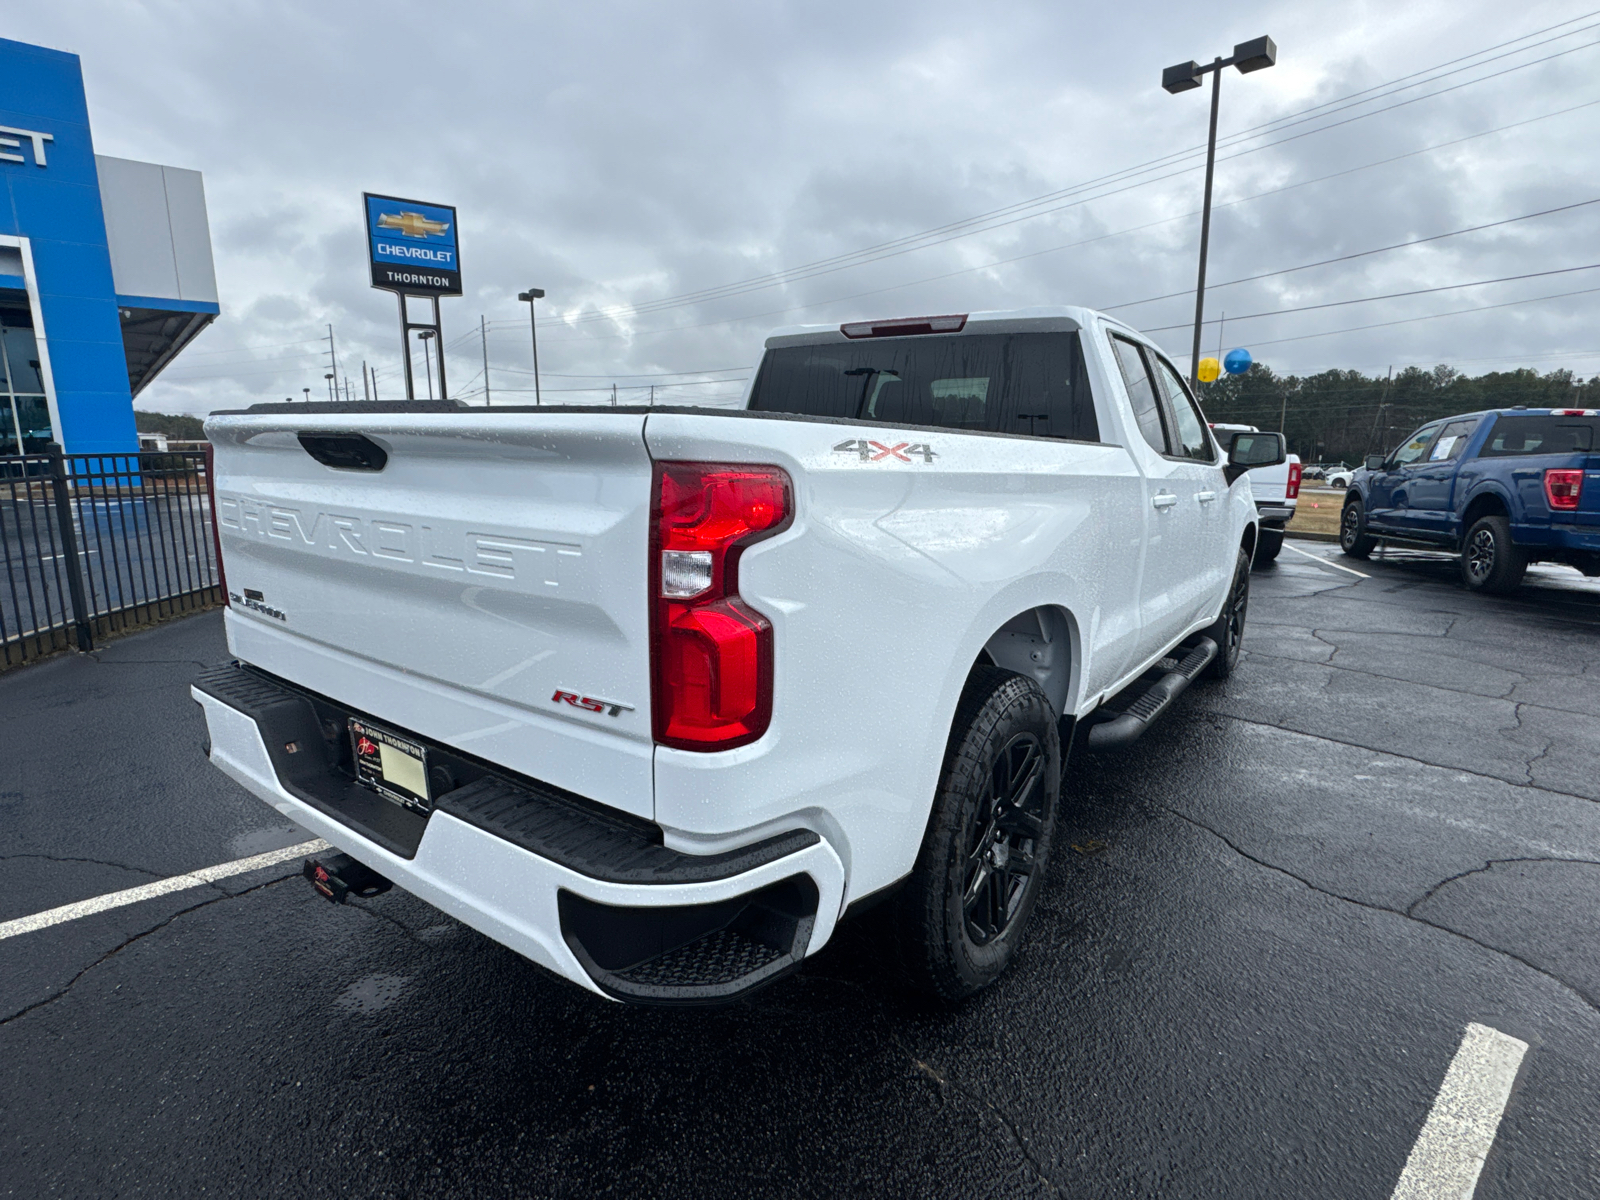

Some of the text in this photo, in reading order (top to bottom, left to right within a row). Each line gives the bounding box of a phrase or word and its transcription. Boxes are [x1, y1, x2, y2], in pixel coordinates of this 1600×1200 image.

[377, 243, 452, 262] CHEVROLET
[386, 271, 450, 287] THORNTON
[219, 498, 582, 586] CHEVROLET
[551, 686, 635, 717] RST
[365, 727, 382, 741] JOHN
